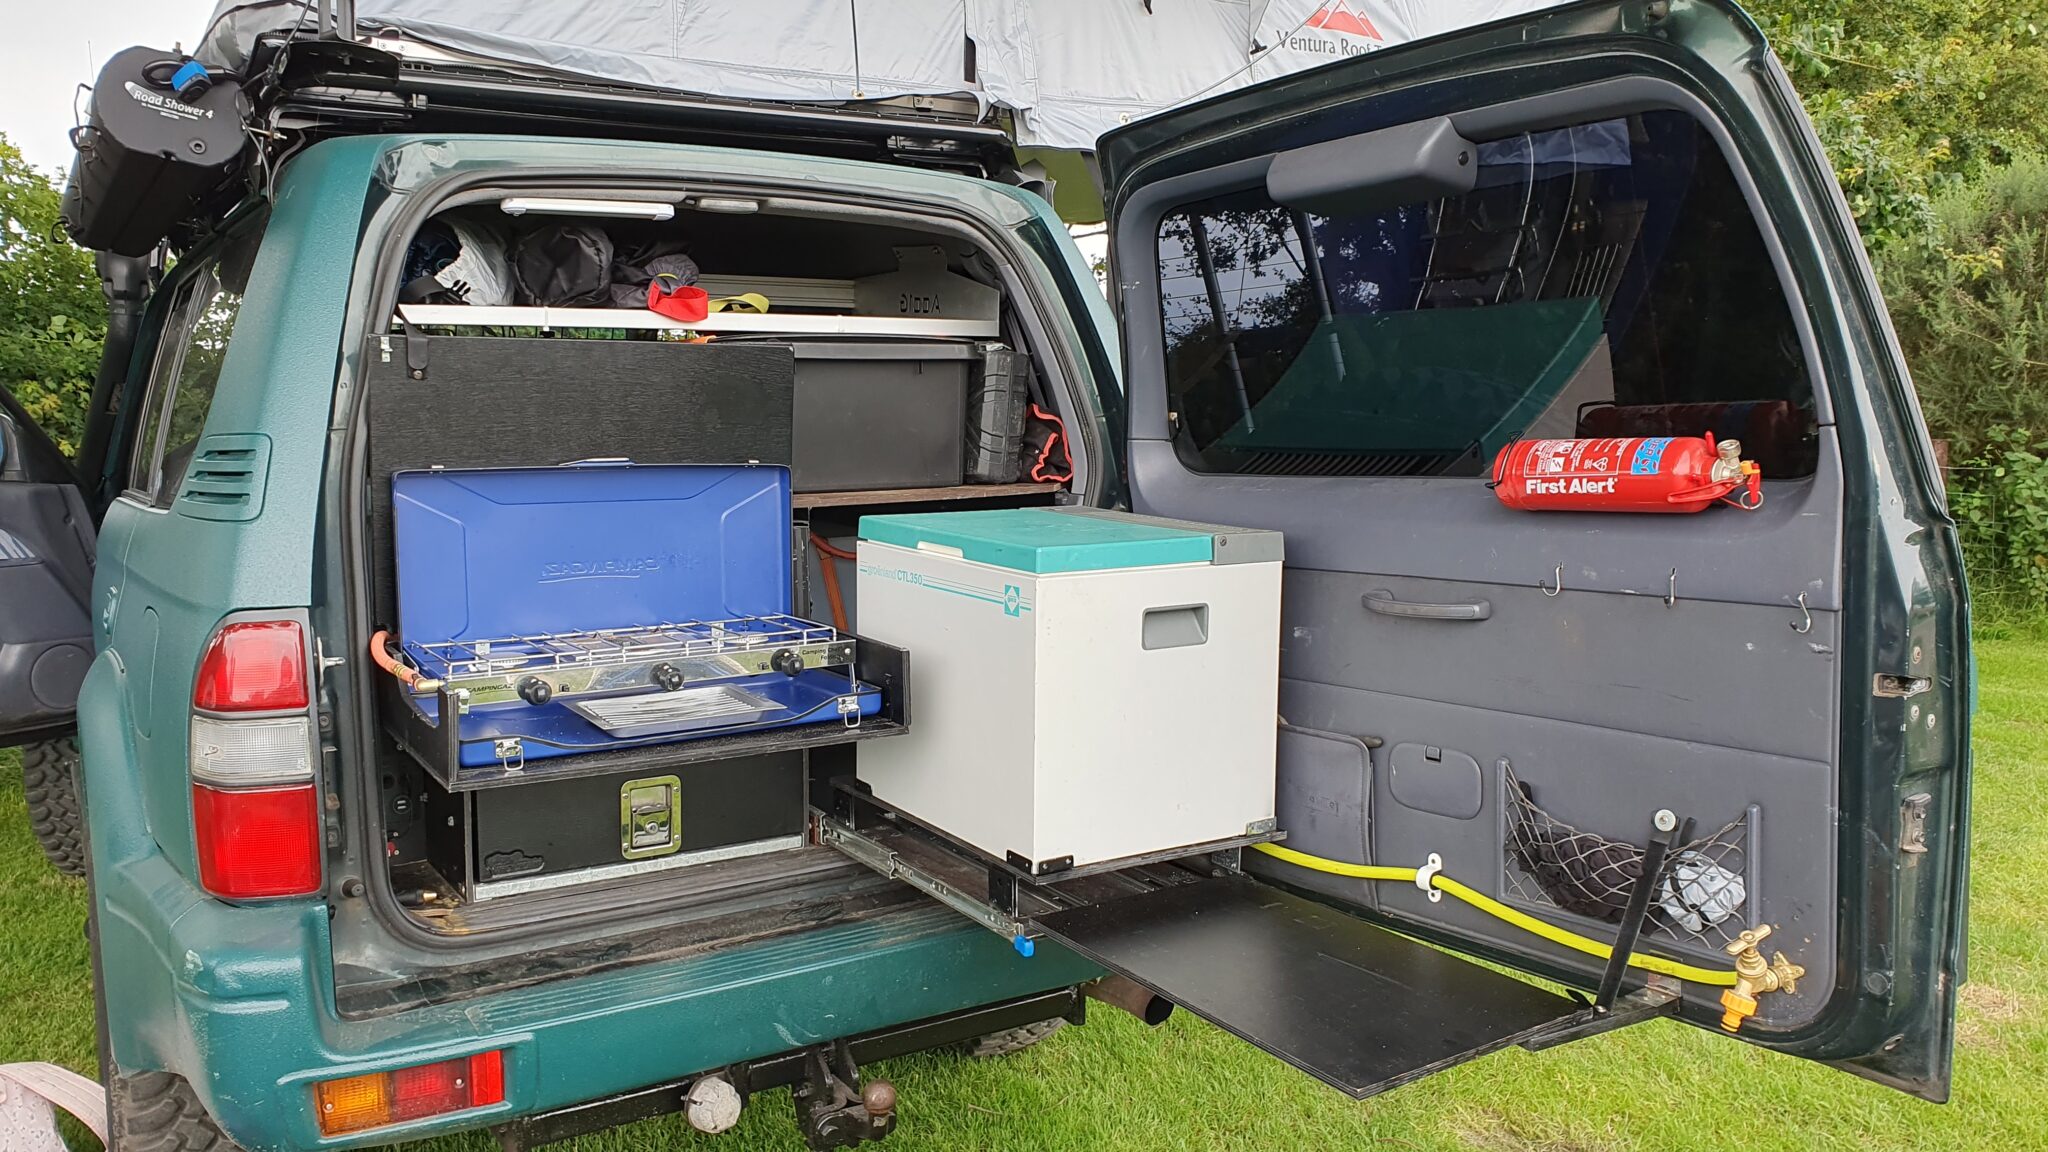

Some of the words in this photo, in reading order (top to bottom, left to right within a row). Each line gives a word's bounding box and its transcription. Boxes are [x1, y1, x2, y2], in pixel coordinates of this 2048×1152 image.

[1276, 30, 1336, 54] Ventura
[134, 90, 163, 105] Road
[164, 98, 205, 116] Shower
[205, 110, 214, 119] 4
[1526, 478, 1567, 494] First
[1568, 478, 1616, 494] Alert
[897, 569, 923, 586] CTL350
[802, 648, 827, 656] Camping
